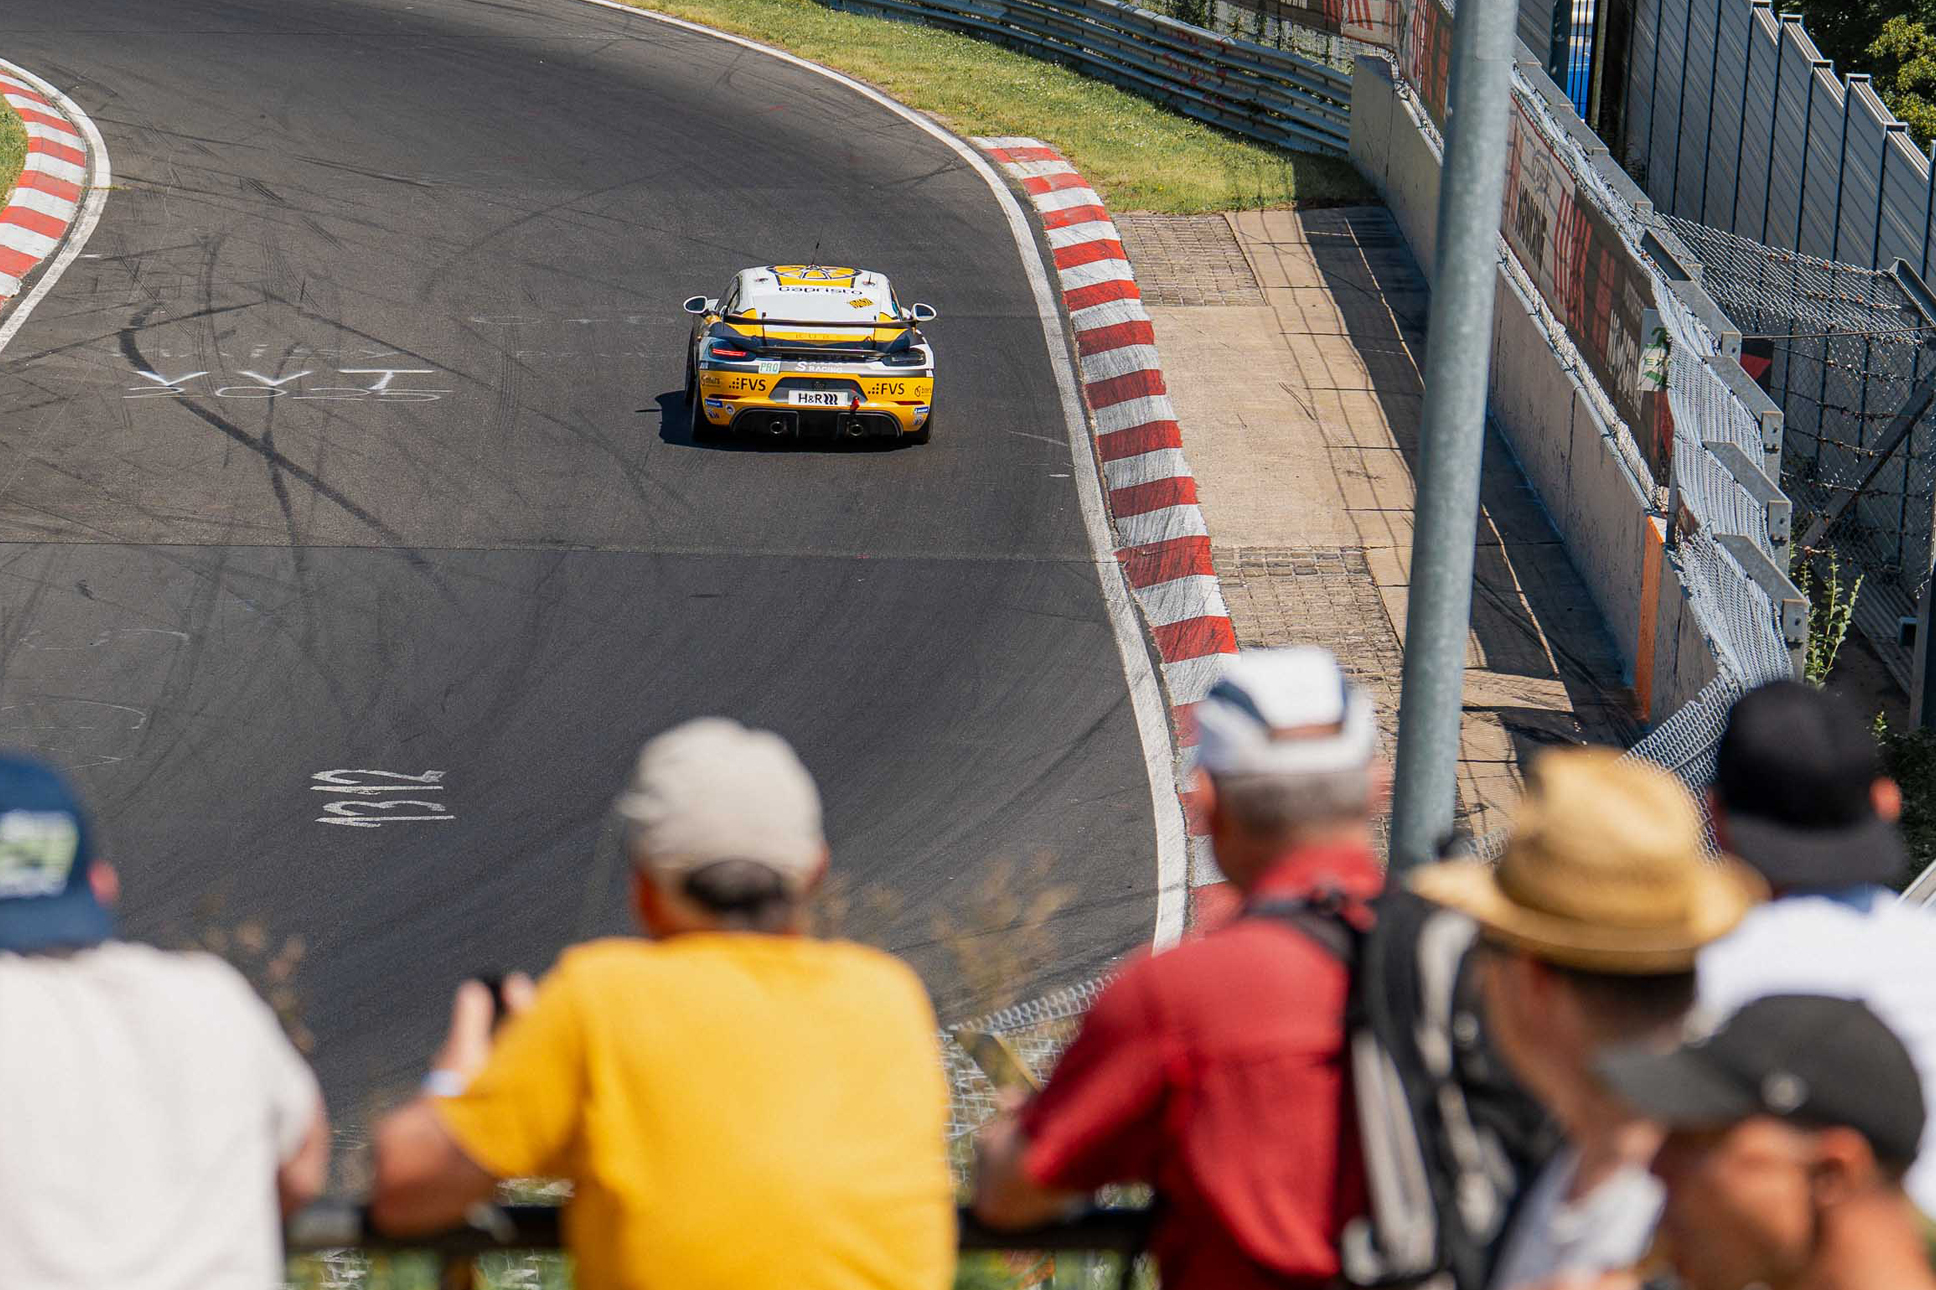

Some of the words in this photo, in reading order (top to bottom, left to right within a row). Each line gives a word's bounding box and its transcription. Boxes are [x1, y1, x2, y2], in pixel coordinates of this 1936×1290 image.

[760, 362, 779, 373] PRO
[808, 365, 844, 374] RACING
[741, 377, 767, 392] FVS
[881, 382, 906, 396] FVS
[798, 392, 823, 404] H&R
